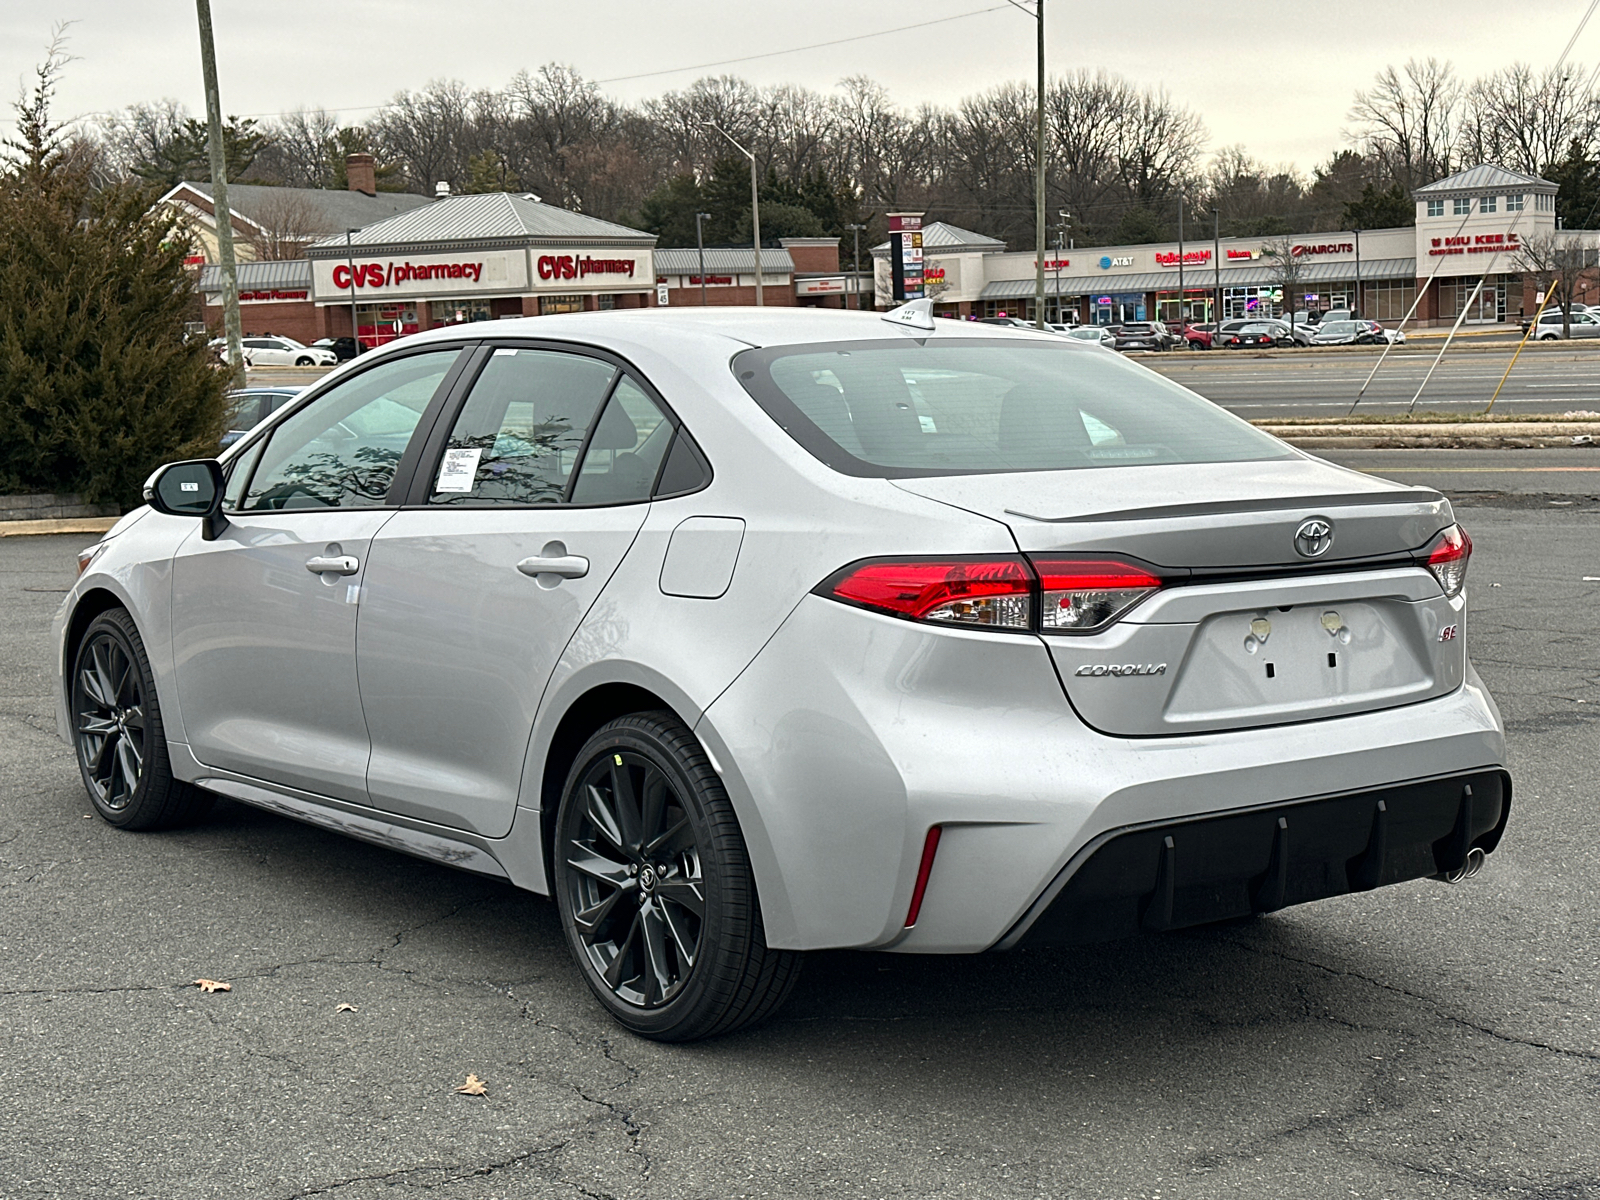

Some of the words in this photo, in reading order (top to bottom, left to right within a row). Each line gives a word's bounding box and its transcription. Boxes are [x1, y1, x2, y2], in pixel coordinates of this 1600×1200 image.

[1445, 235, 1470, 247] MIU
[1475, 233, 1504, 245] KEE
[1303, 243, 1354, 255] HAIRCUTS
[1428, 247, 1464, 256] CHINESE
[1467, 244, 1521, 255] RESTAURANT
[537, 254, 636, 280] CVS/pharmacy
[1112, 256, 1134, 267] AT&T
[332, 261, 483, 289] CVS/pharmacy
[660, 294, 668, 304] 45
[1437, 624, 1457, 643] SE
[1074, 663, 1168, 678] COROLLA
